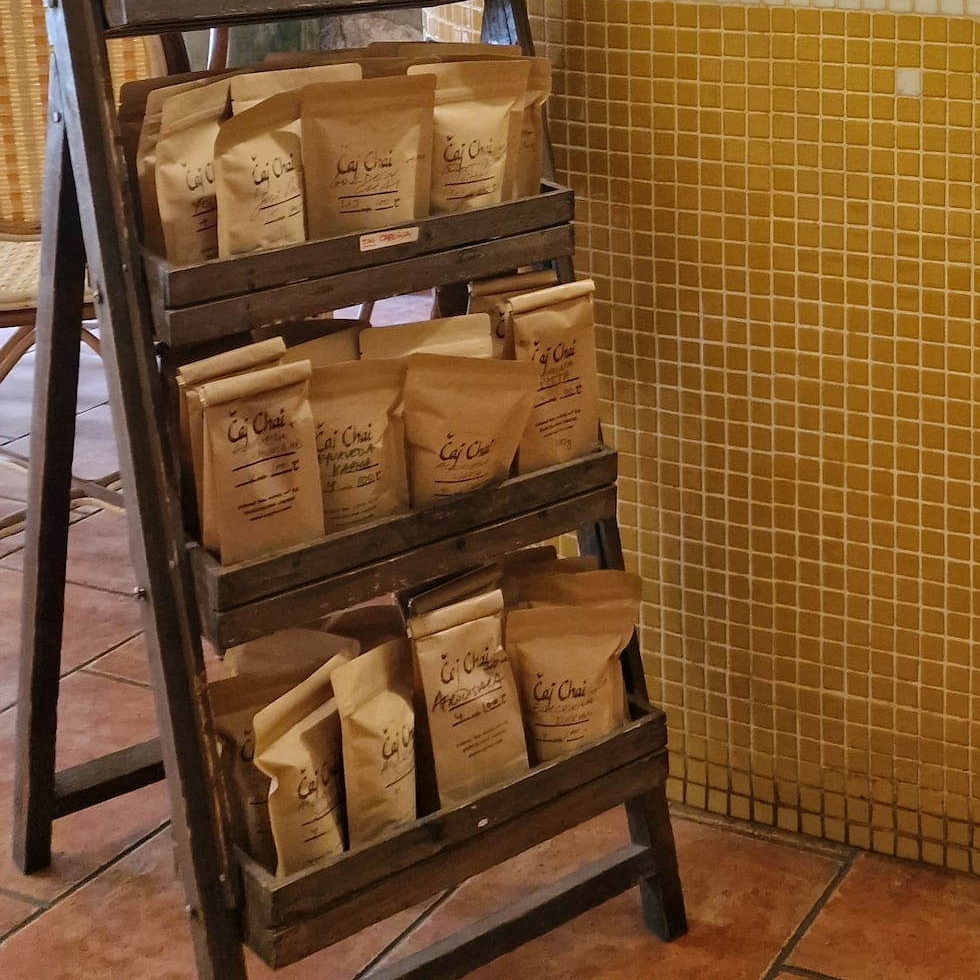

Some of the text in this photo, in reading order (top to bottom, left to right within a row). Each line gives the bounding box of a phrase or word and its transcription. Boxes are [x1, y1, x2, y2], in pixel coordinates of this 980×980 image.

[363, 150, 393, 172] Chai
[252, 408, 286, 435] Chai
[341, 423, 373, 448] Chai
[463, 647, 490, 674] Chai
[558, 679, 586, 701] Chai
